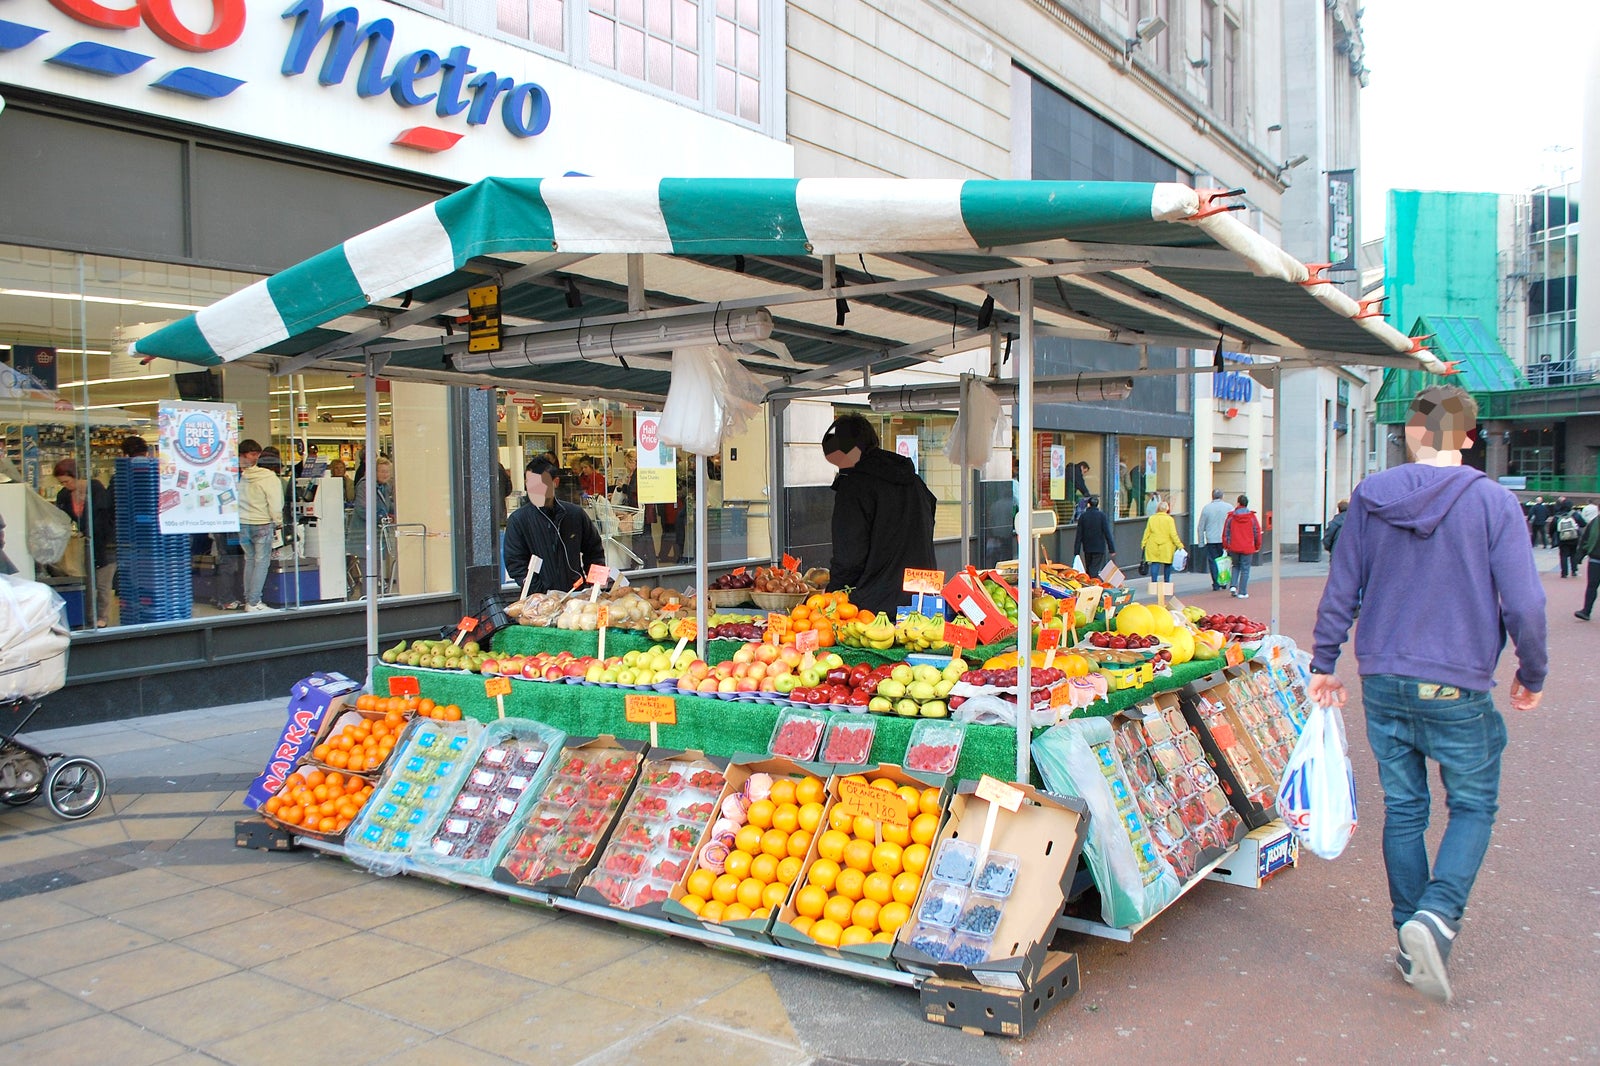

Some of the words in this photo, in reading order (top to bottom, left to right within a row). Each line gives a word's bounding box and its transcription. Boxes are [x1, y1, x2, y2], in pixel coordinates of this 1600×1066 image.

[196, 420, 213, 428] NEW
[185, 428, 214, 438] PRICE
[642, 425, 656, 434] Half
[641, 434, 657, 444] Price
[263, 710, 315, 794] NARKA
[846, 784, 887, 802] ORANGES
[849, 797, 864, 812] 4
